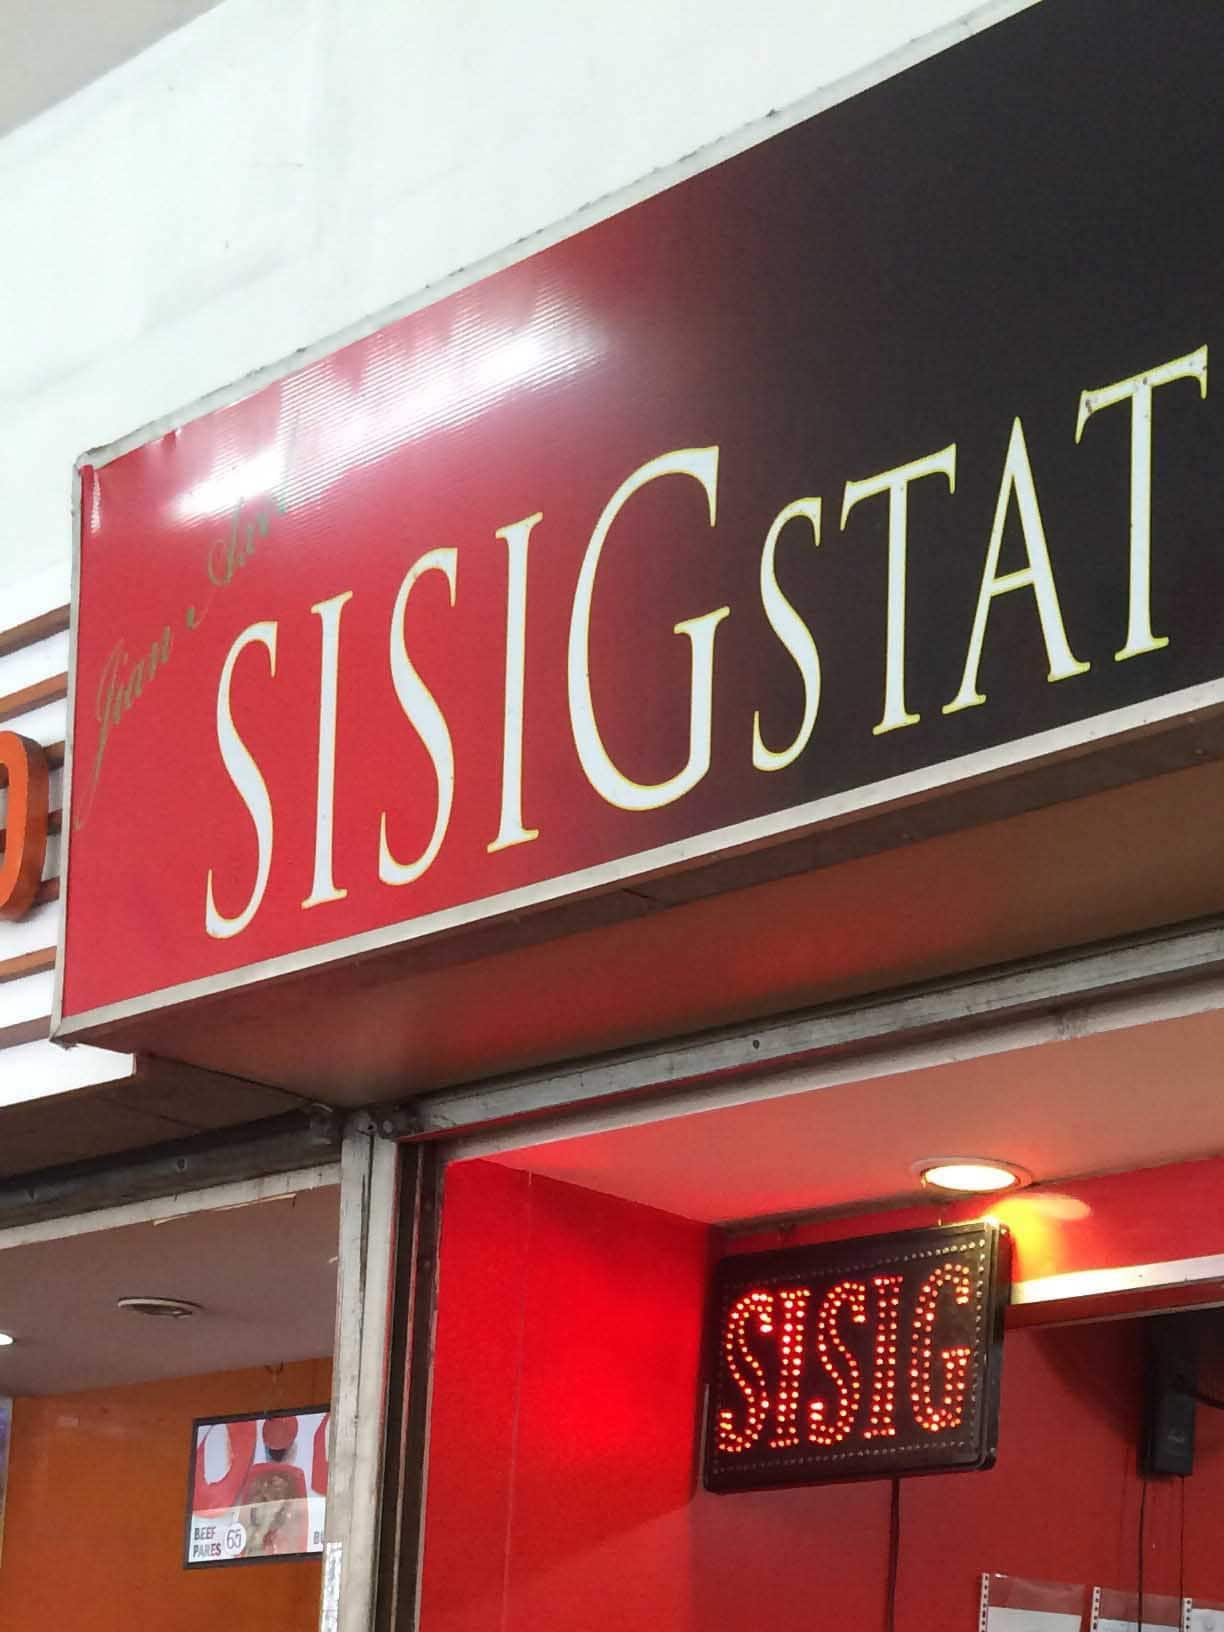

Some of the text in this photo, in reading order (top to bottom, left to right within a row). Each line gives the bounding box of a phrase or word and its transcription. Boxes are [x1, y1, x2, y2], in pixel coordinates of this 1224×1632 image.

[718, 1263, 972, 1453] SISIG
[194, 1527, 216, 1541] BEEF
[193, 1543, 221, 1558] PARES
